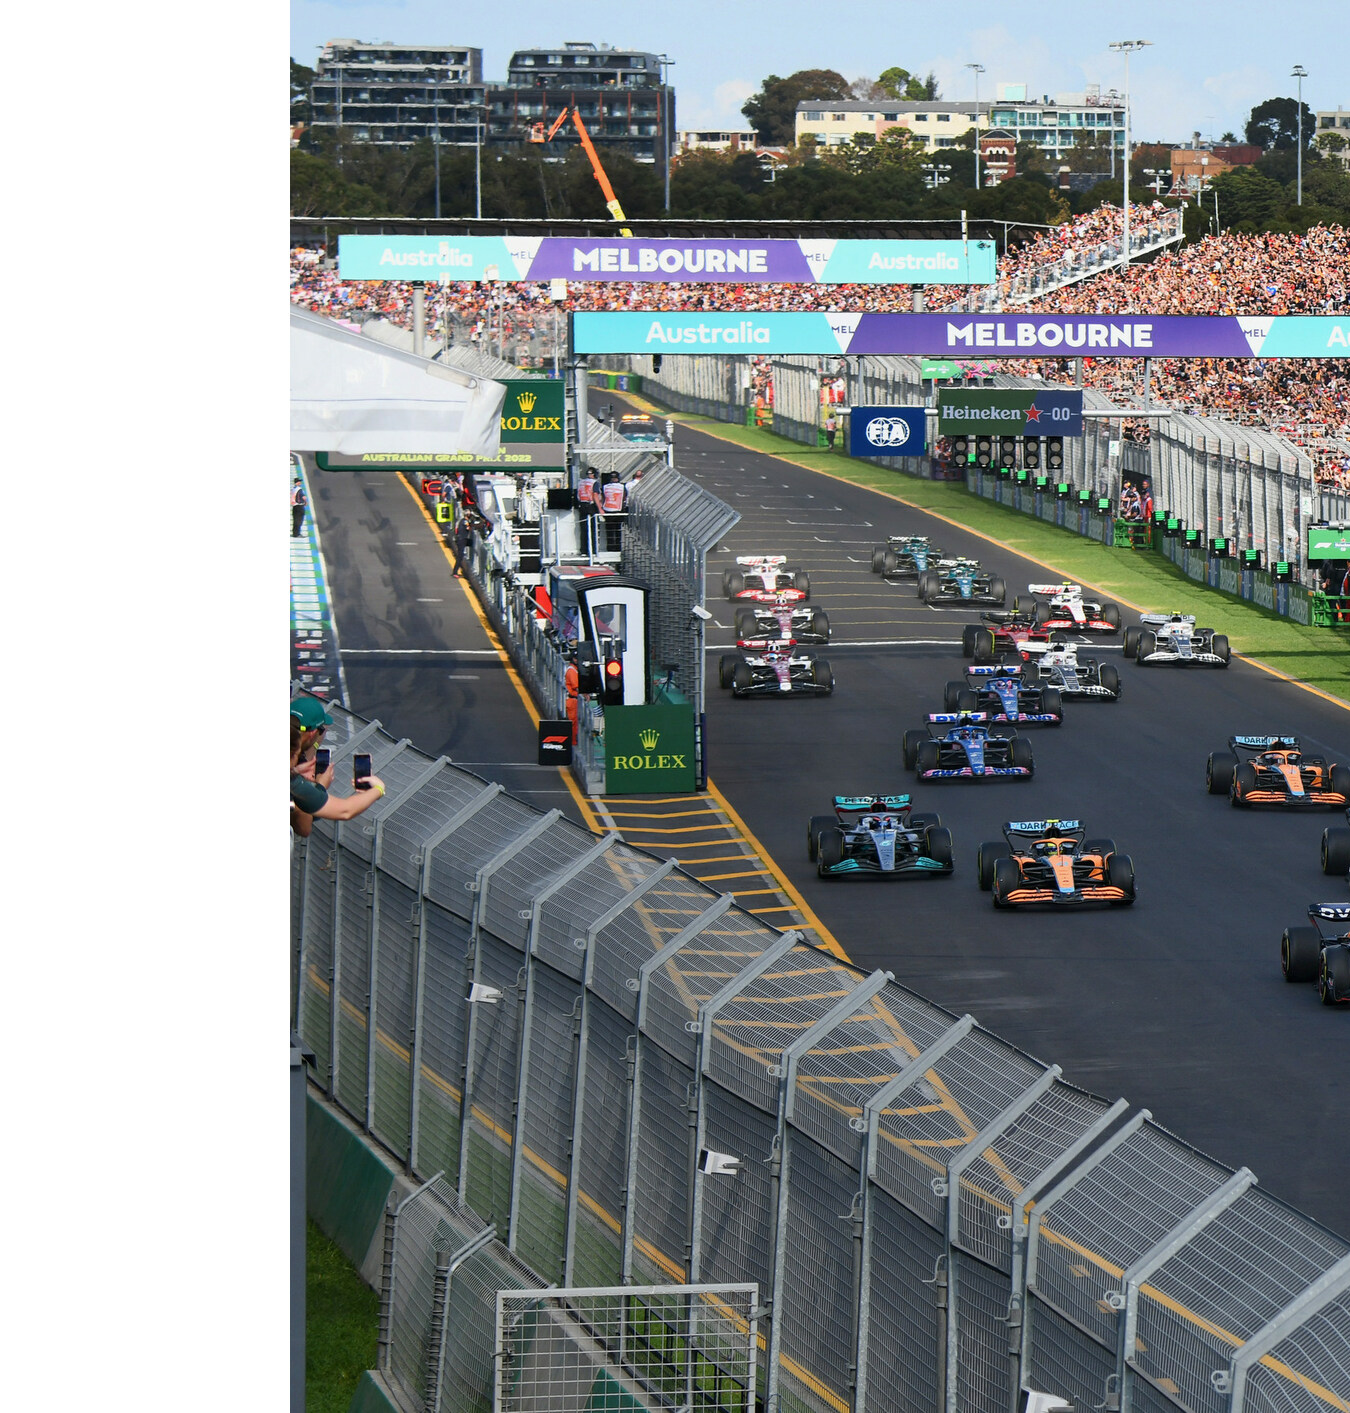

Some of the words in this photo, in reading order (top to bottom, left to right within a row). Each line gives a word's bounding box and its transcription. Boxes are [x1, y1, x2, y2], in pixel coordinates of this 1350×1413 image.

[379, 248, 473, 267] Australia
[573, 247, 768, 273] MELBOURNE
[868, 252, 959, 270] Australia
[645, 321, 770, 344] Australia
[946, 322, 1153, 348] MELBOURNE
[942, 405, 1021, 421] Heineken
[504, 453, 532, 463] 2022
[613, 754, 687, 770] ROLEX
